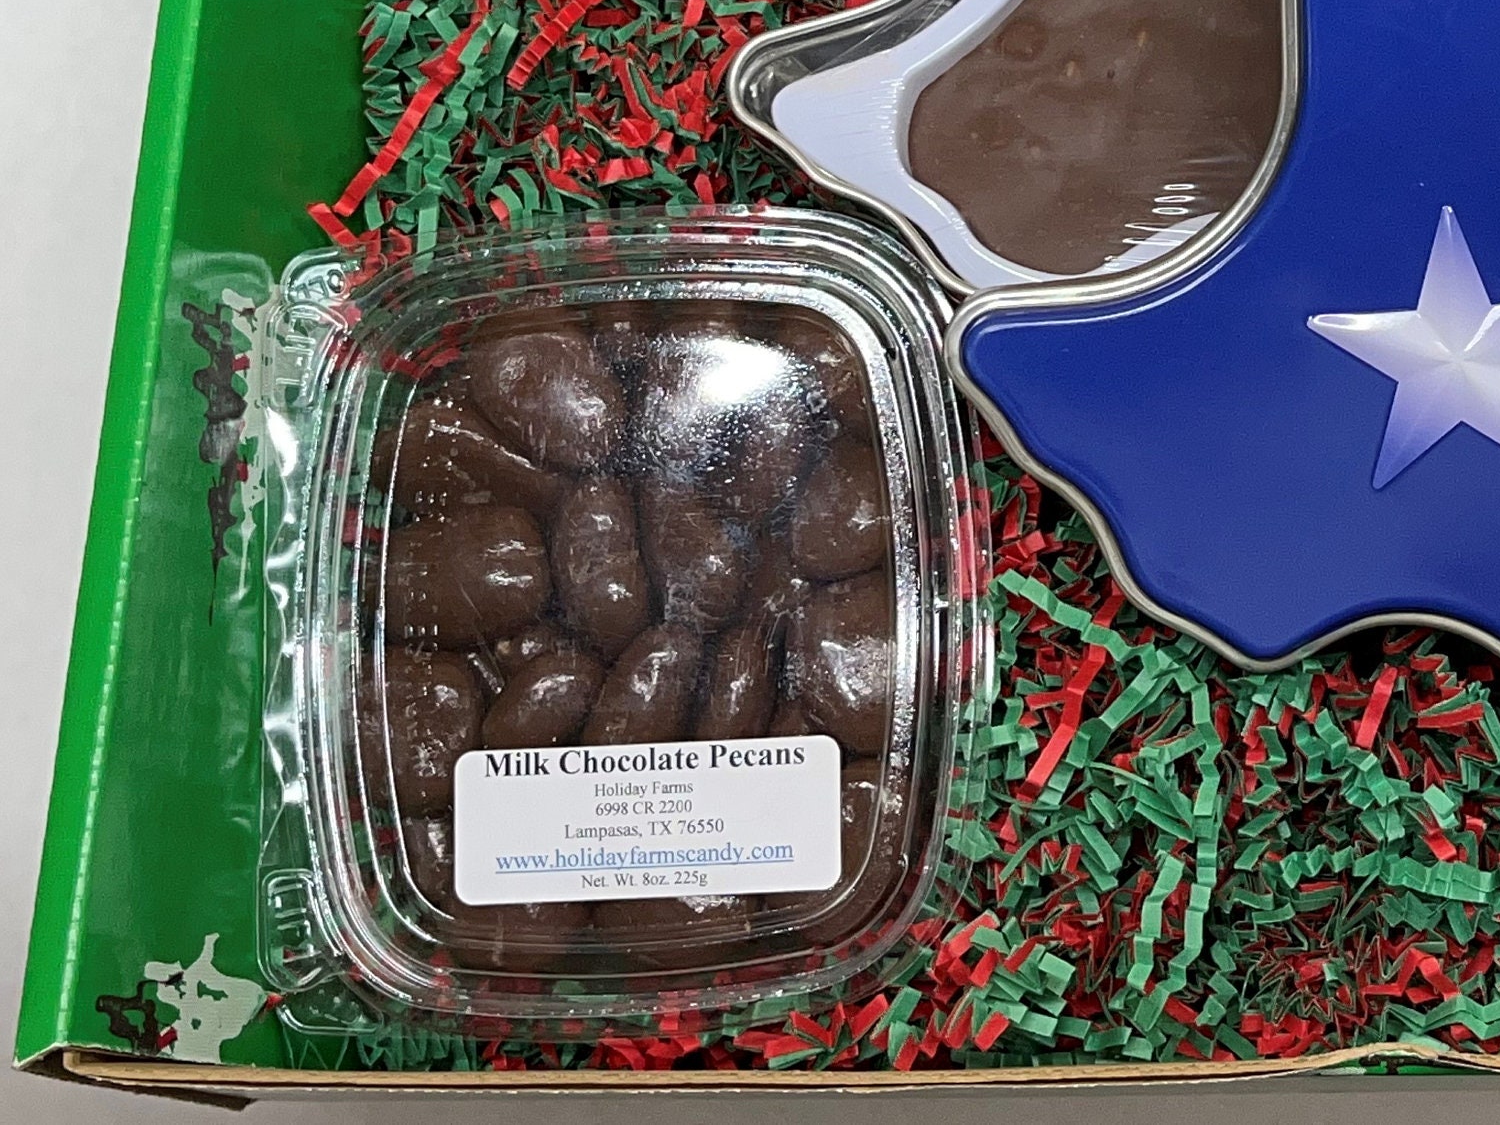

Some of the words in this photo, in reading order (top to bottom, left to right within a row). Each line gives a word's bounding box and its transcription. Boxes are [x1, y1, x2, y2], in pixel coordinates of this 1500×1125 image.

[484, 751, 550, 777] Milk
[558, 746, 700, 775] Chocolate
[708, 744, 805, 769] Pecans
[594, 782, 649, 798] Holiday
[652, 781, 694, 795] Farms
[595, 801, 629, 816] 6998
[632, 801, 655, 815] CR
[658, 799, 693, 814] 2200
[564, 822, 643, 843] Lampasas,
[647, 820, 673, 836] TX
[677, 818, 724, 835] 76550
[495, 842, 794, 874] www.holidayfarmscandy.com
[674, 870, 708, 887] 225g
